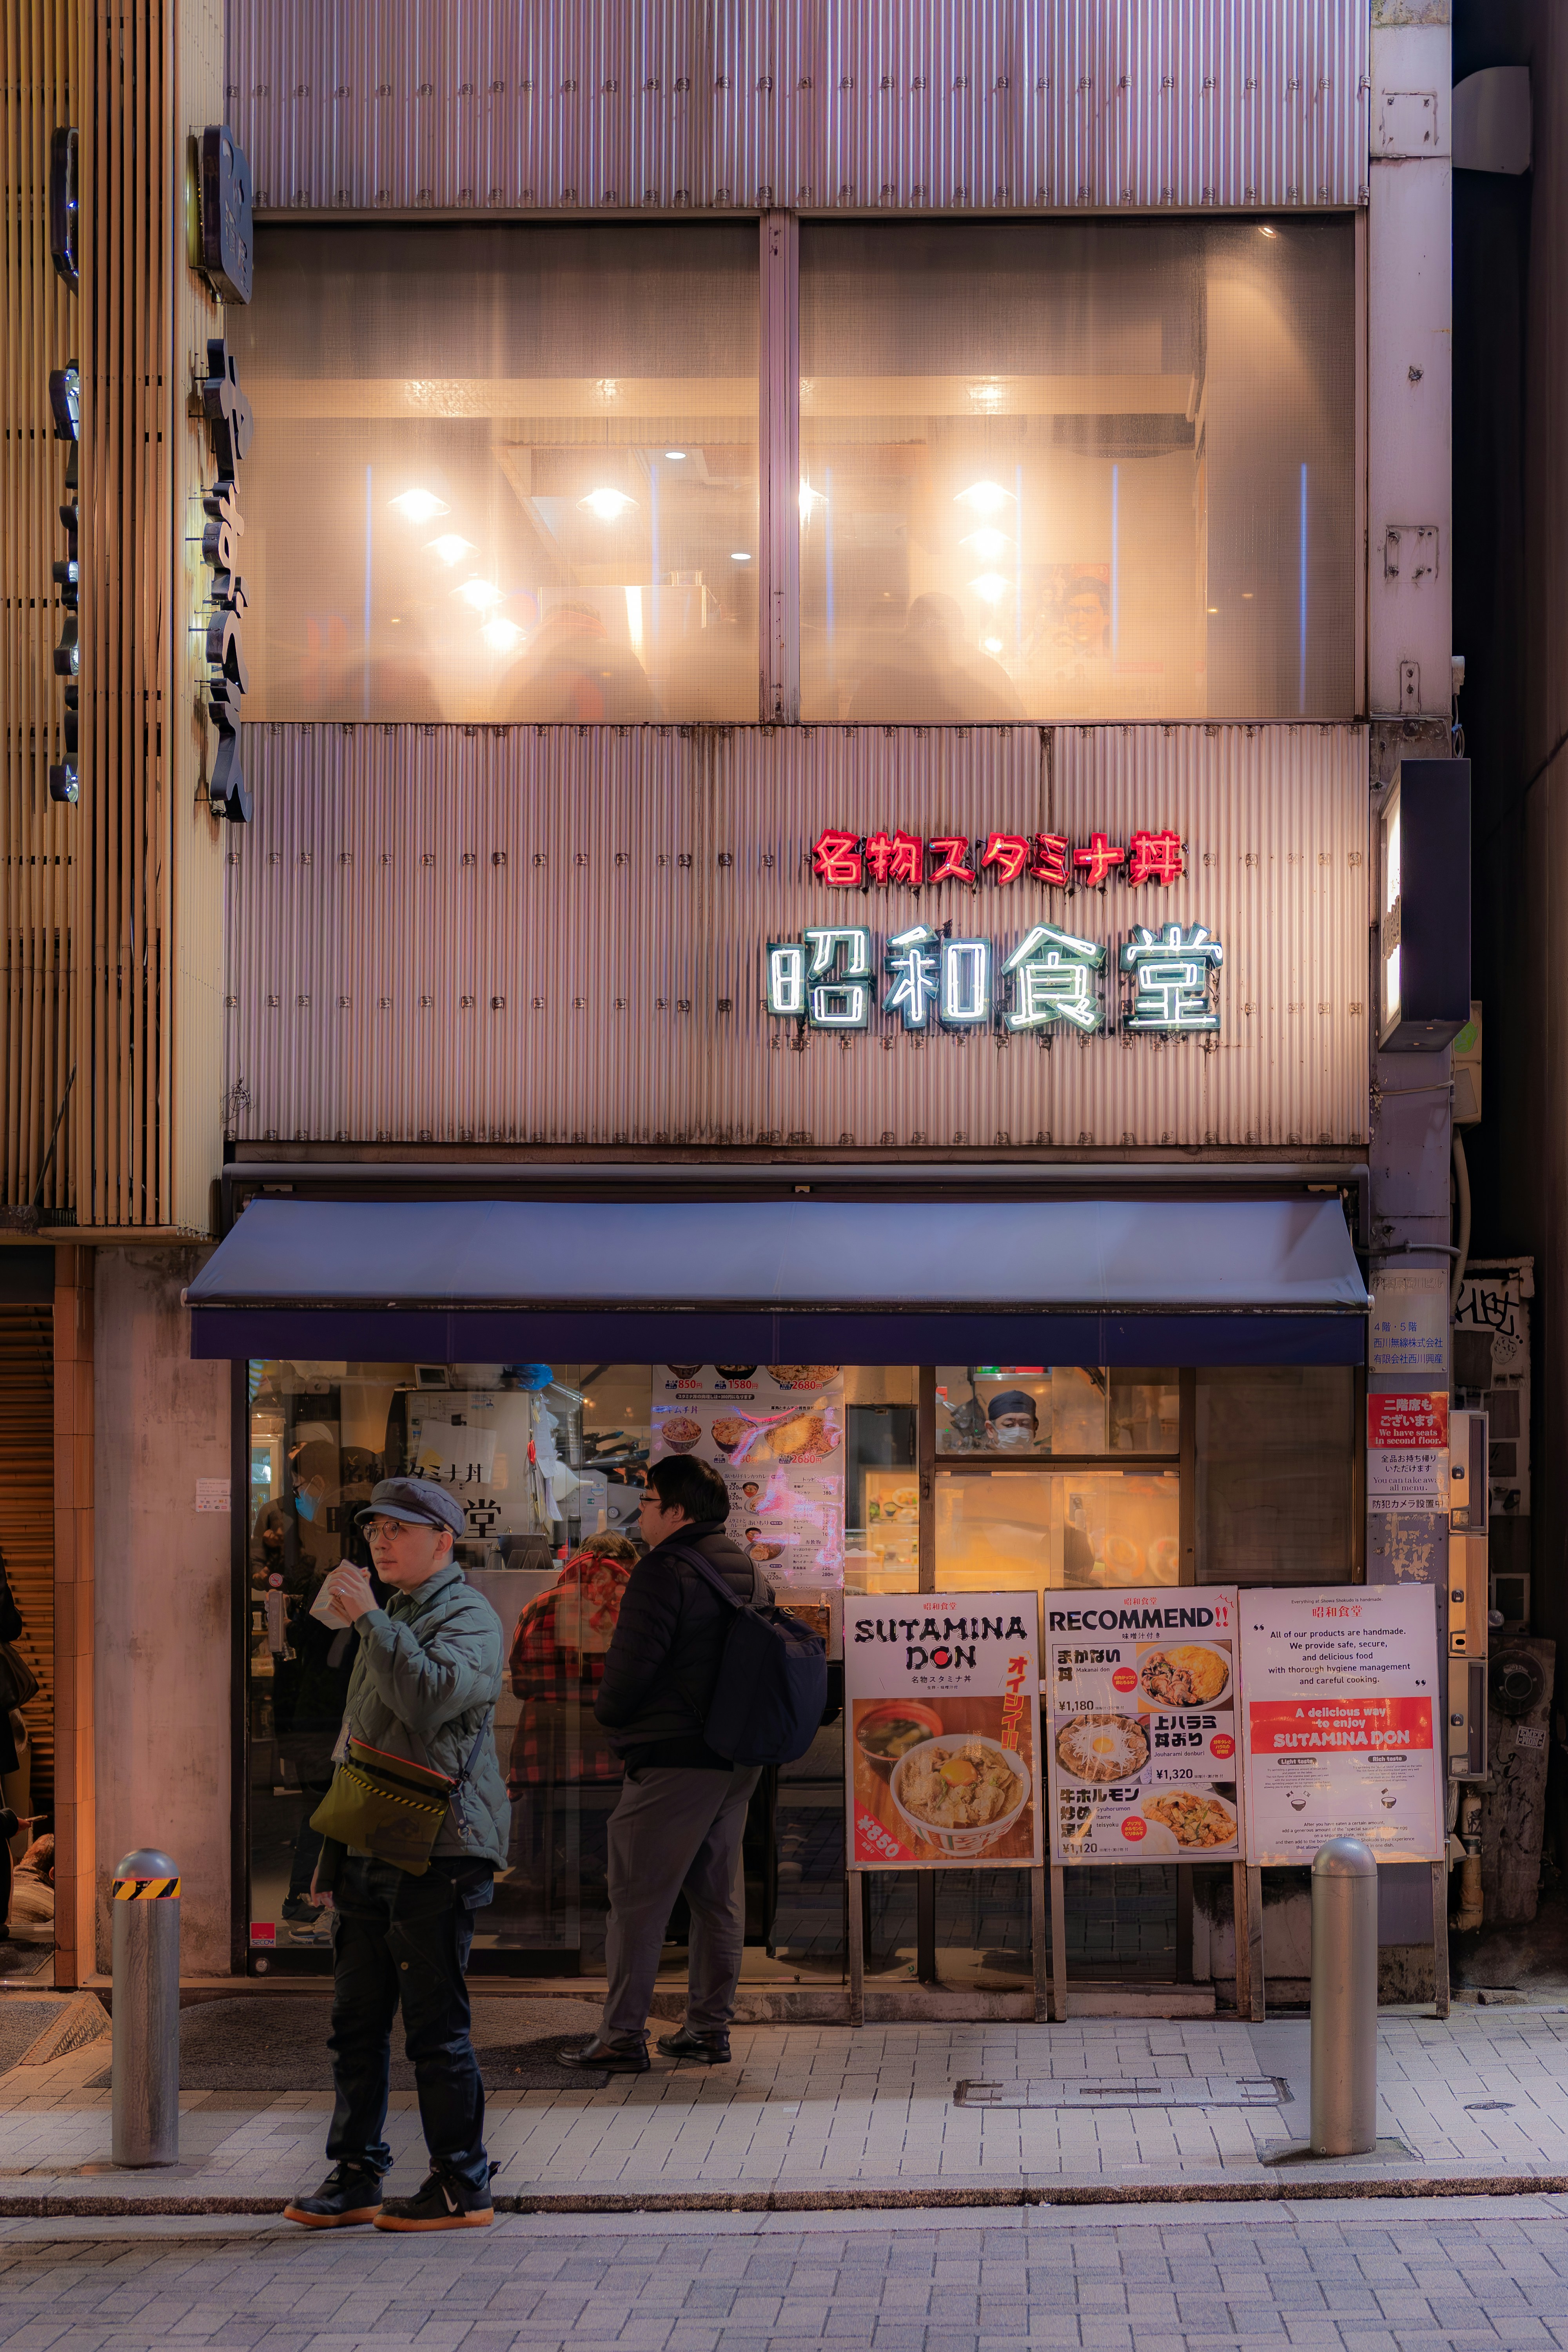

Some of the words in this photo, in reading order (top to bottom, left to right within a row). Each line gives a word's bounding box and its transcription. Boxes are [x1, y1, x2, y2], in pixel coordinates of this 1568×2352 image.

[813, 829, 1183, 887] 名物スタミナ丼
[766, 921, 1223, 1034] 昭和食堂
[1373, 1337, 1443, 1348] 西川無線株式会社
[1374, 1354, 1443, 1364] 有限会社西川興産
[728, 1379, 758, 1389] 1580円
[792, 1381, 822, 1389] 2680円
[1384, 1399, 1432, 1411] 二階席も
[1381, 1414, 1437, 1427] ございます
[791, 1455, 822, 1464] 2680円
[1372, 1499, 1443, 1509] 防犯カメラ設置中
[923, 1602, 957, 1611] 昭和食堂
[1123, 1597, 1158, 1606] 昭和食堂
[1312, 1605, 1363, 1618] 昭和食堂
[854, 1616, 1028, 1643] SUTAMINA
[1310, 1630, 1345, 1638] products
[1305, 1641, 1335, 1650] provide
[1338, 1641, 1356, 1649] safe,
[905, 1645, 977, 1670] DON
[1057, 1649, 1121, 1664] まかない
[1288, 1665, 1324, 1674] thorough
[1327, 1665, 1357, 1673] hygiene
[1359, 1663, 1410, 1671] management
[911, 1675, 972, 1684] 名物スタミナ丼
[1347, 1675, 1379, 1684] cooking.
[1059, 1700, 1094, 1713] ¥1,180
[1295, 1708, 1305, 1718] A
[1308, 1707, 1360, 1717] delicious
[1364, 1708, 1386, 1717] way
[1154, 1715, 1217, 1731] 上ハラミ
[1317, 1719, 1329, 1728] to
[1333, 1717, 1366, 1728] enjoy
[1154, 1732, 1203, 1748] 丼ぶり
[1273, 1731, 1368, 1748] SUTAMINA
[1371, 1730, 1410, 1745] DON
[1156, 1768, 1193, 1781] ¥1,320
[1060, 1788, 1139, 1804] 牛ホルモン
[857, 1815, 900, 1858] ¥850
[1063, 1843, 1097, 1855] ¥1,120
